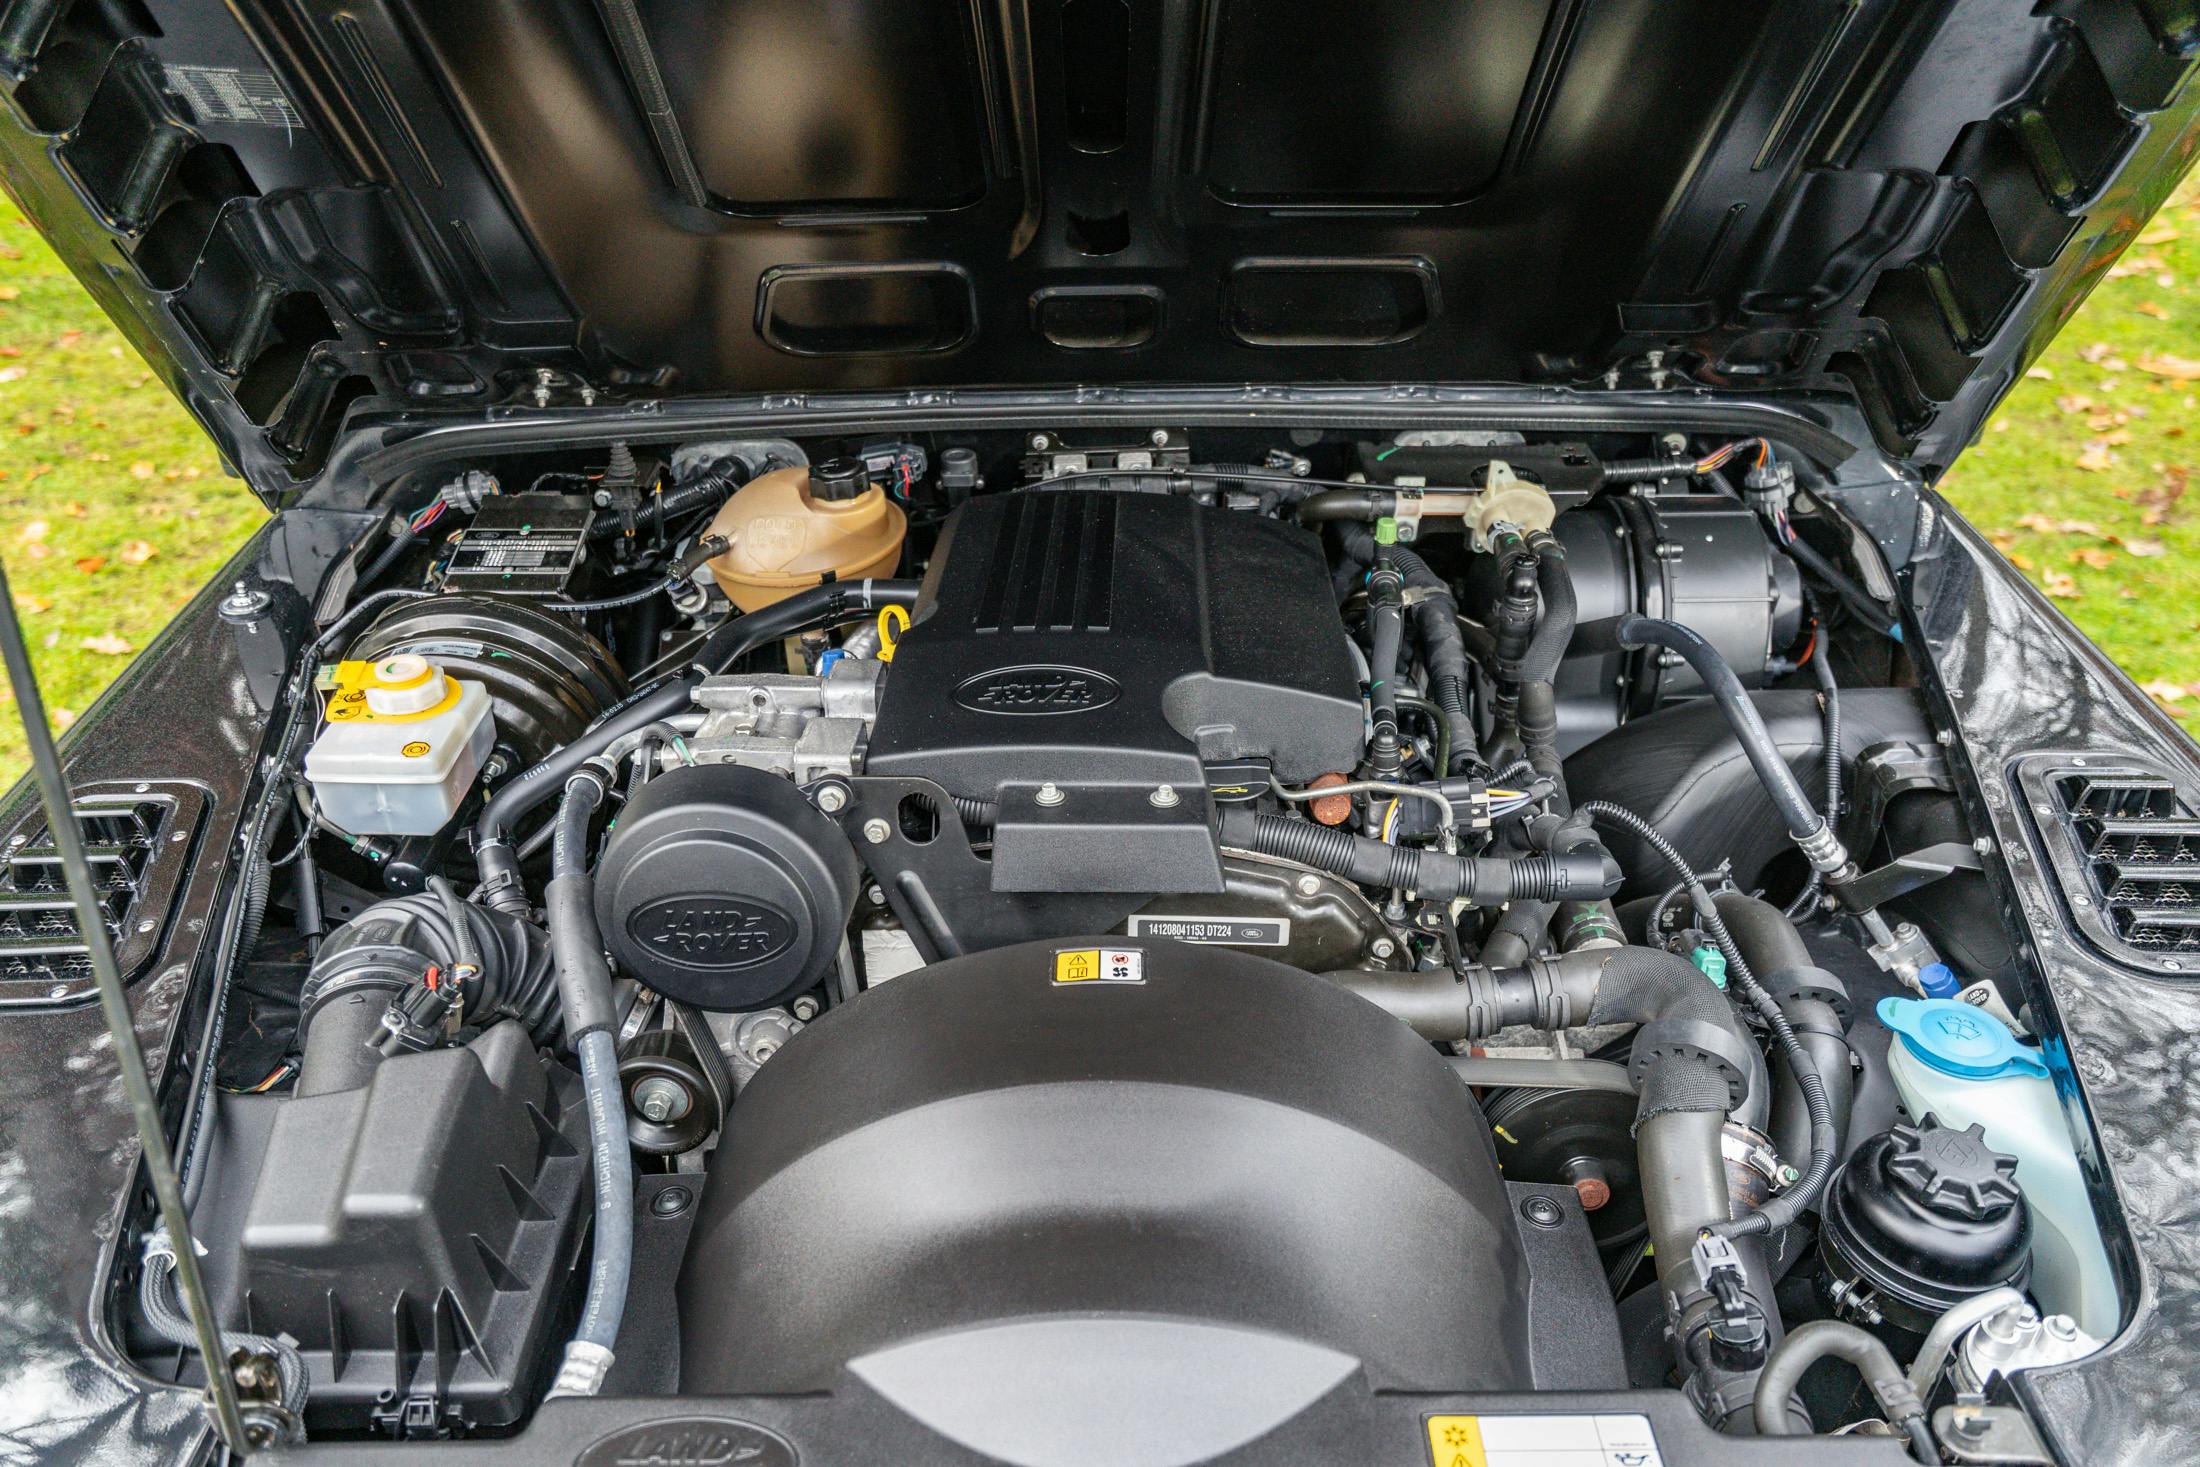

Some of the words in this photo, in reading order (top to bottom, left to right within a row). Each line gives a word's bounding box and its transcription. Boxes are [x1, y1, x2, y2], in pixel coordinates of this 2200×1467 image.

[1149, 923, 1205, 936] 141208041153
[1207, 925, 1232, 937] DT224
[672, 931, 769, 954] ROVER
